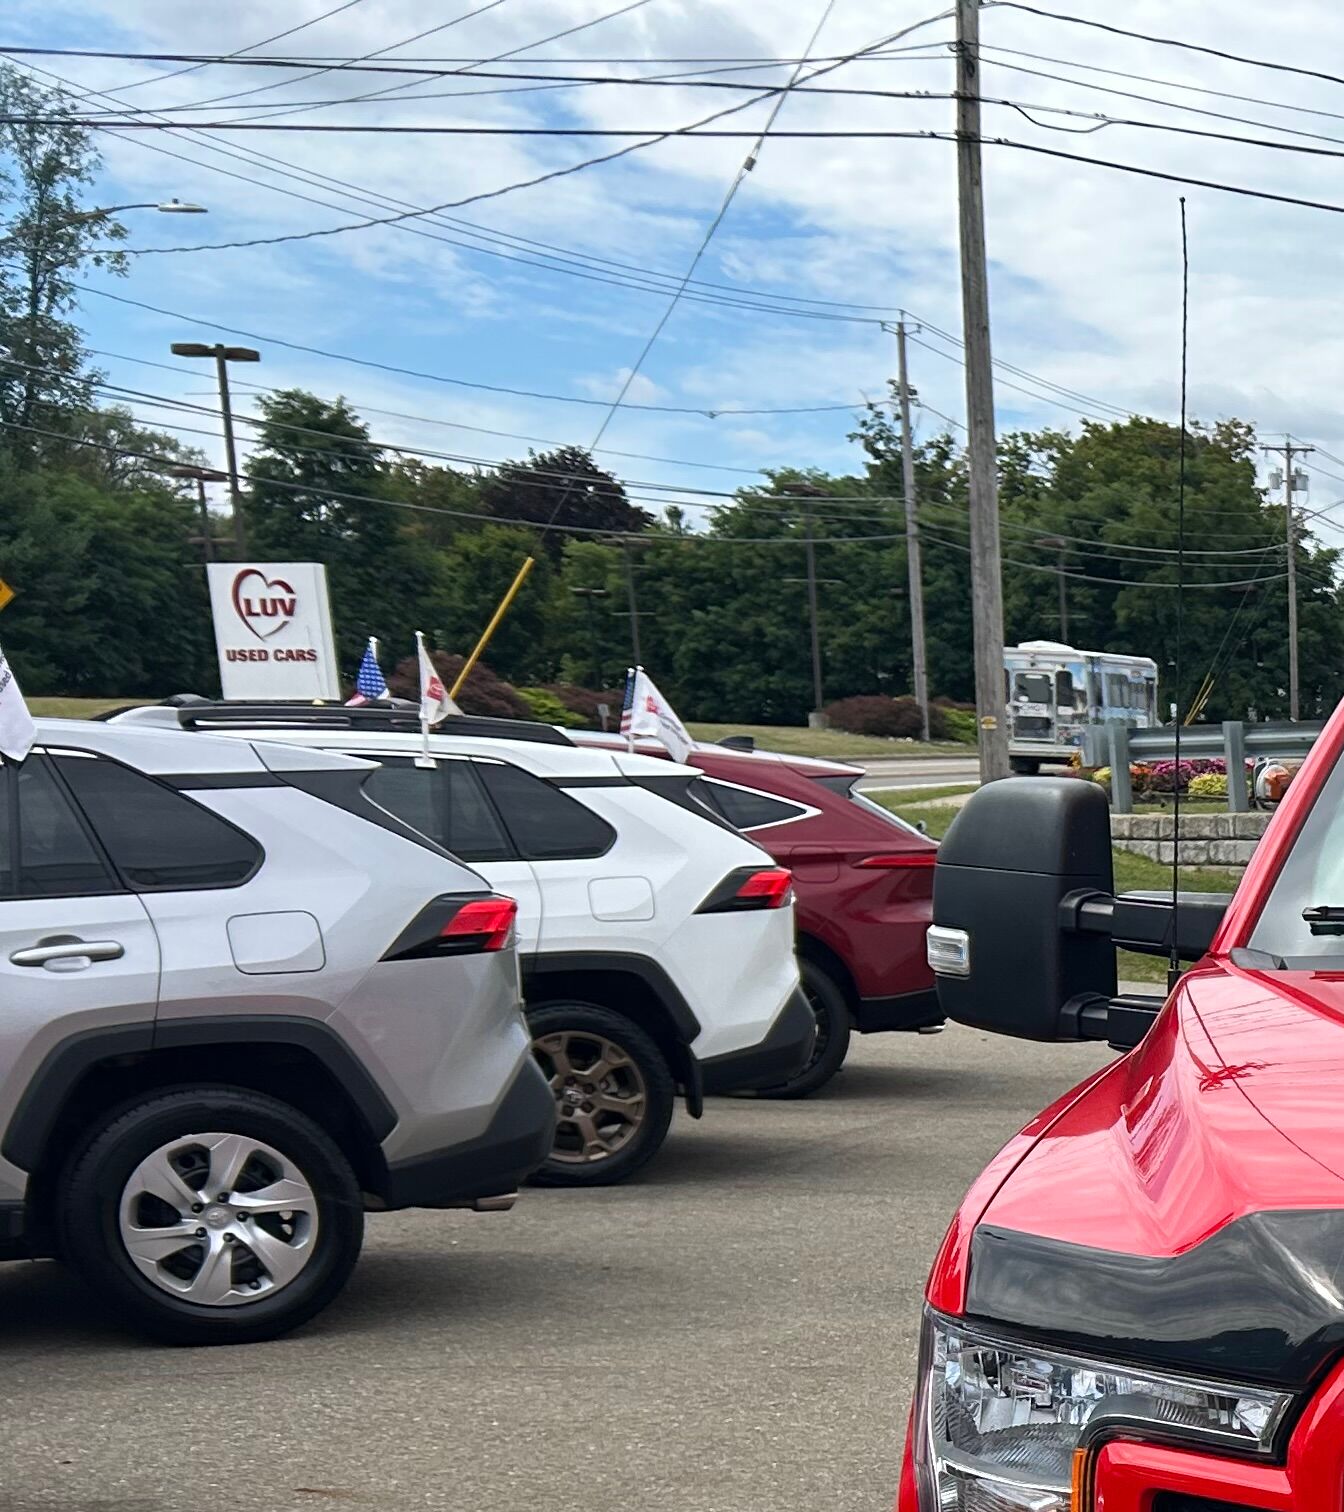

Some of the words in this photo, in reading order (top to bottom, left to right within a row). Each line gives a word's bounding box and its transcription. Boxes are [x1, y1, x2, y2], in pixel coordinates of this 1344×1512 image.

[242, 597, 297, 617] LUV
[225, 648, 269, 662] USED
[273, 648, 318, 662] CARS
